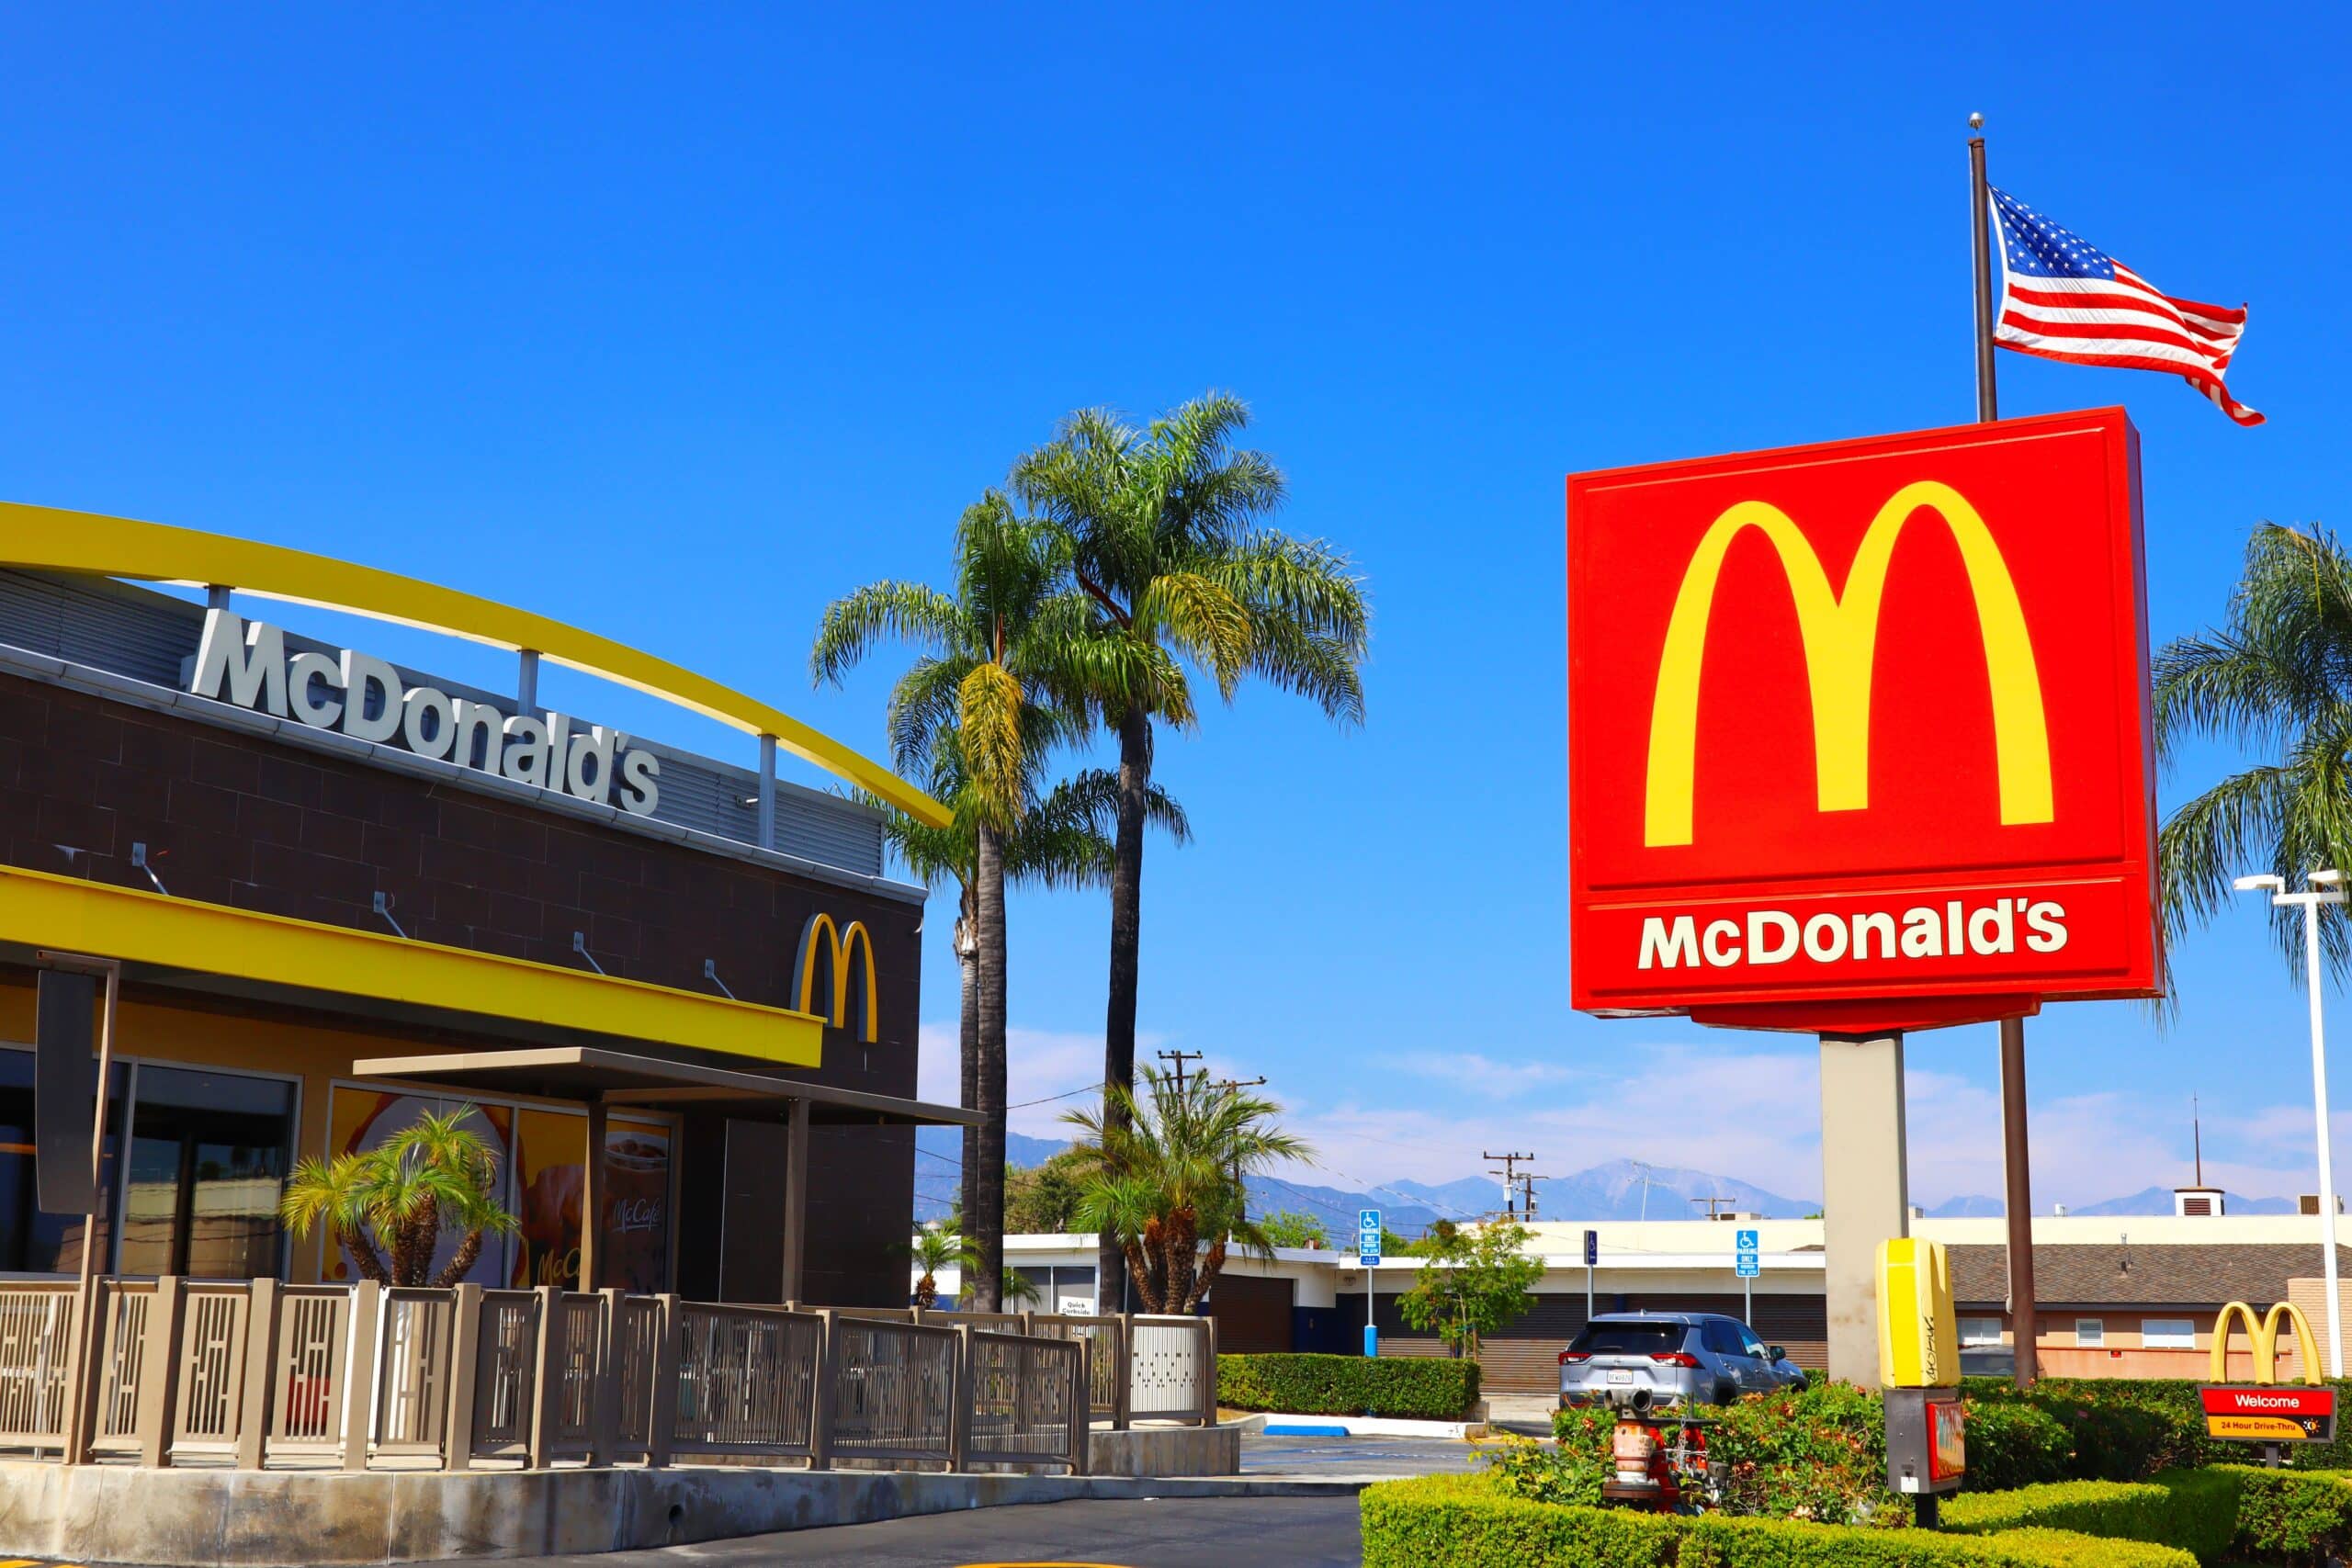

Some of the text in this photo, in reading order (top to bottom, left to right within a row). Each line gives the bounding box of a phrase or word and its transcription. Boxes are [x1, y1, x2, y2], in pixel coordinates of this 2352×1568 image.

[190, 608, 661, 817] McDonald's
[1637, 897, 2068, 970] McDonald's
[614, 1198, 661, 1235] McCafé
[537, 1247, 581, 1287] McC
[1741, 1255, 1753, 1263] ONLY
[1062, 1307, 1091, 1315] Curbside
[2234, 1394, 2301, 1408] Welcome
[2221, 1421, 2296, 1431] 24 Hour Drive-Thru
